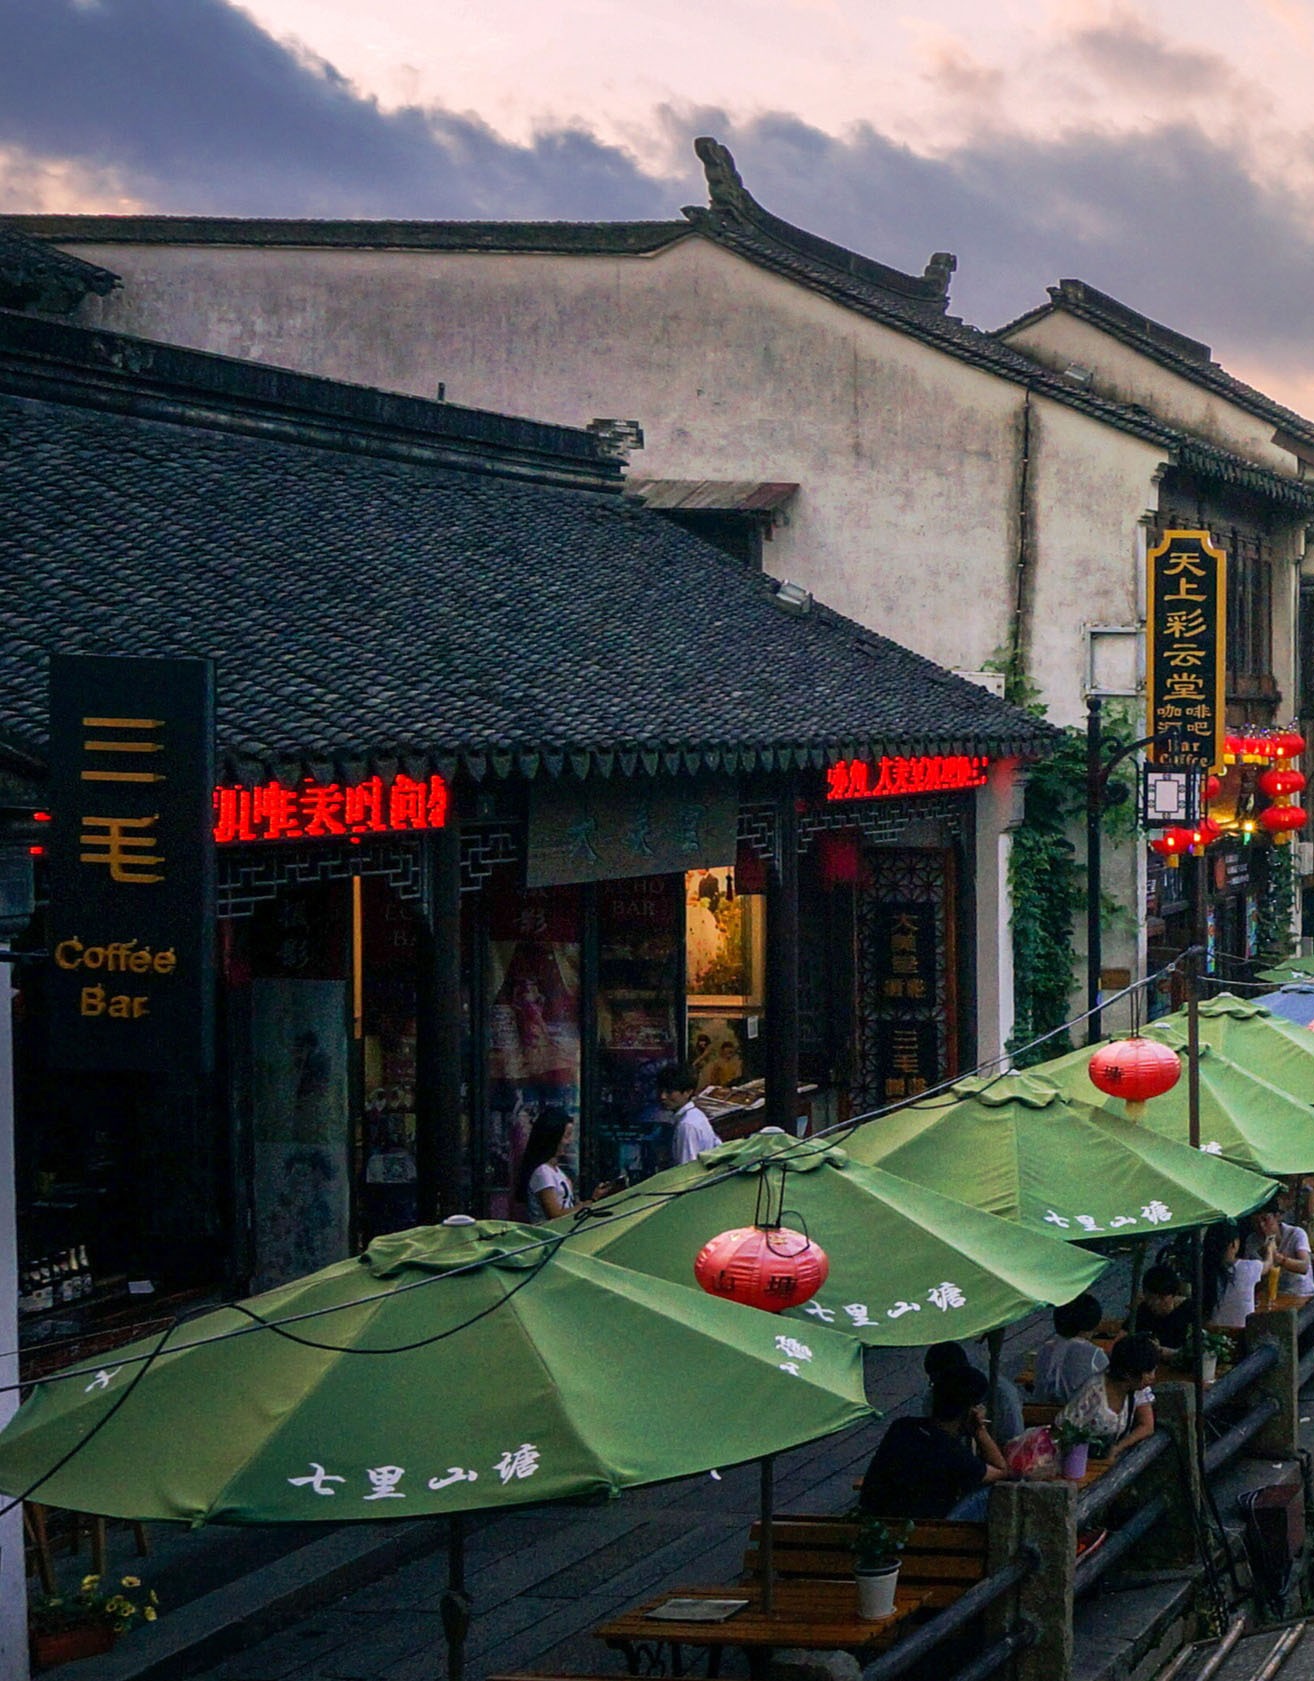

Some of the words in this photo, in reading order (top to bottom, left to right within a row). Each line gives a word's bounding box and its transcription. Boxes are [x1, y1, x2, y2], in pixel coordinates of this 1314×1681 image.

[1162, 552, 1208, 701] 天上彩云堂
[1157, 704, 1212, 719] 咖啡
[80, 717, 166, 883] 三毛
[55, 936, 177, 975] Coffee
[80, 983, 149, 1019] Bar
[1043, 1200, 1173, 1231] 七里山塘
[805, 1281, 967, 1327] 七里山塘
[288, 1443, 541, 1500] 七里山塘
